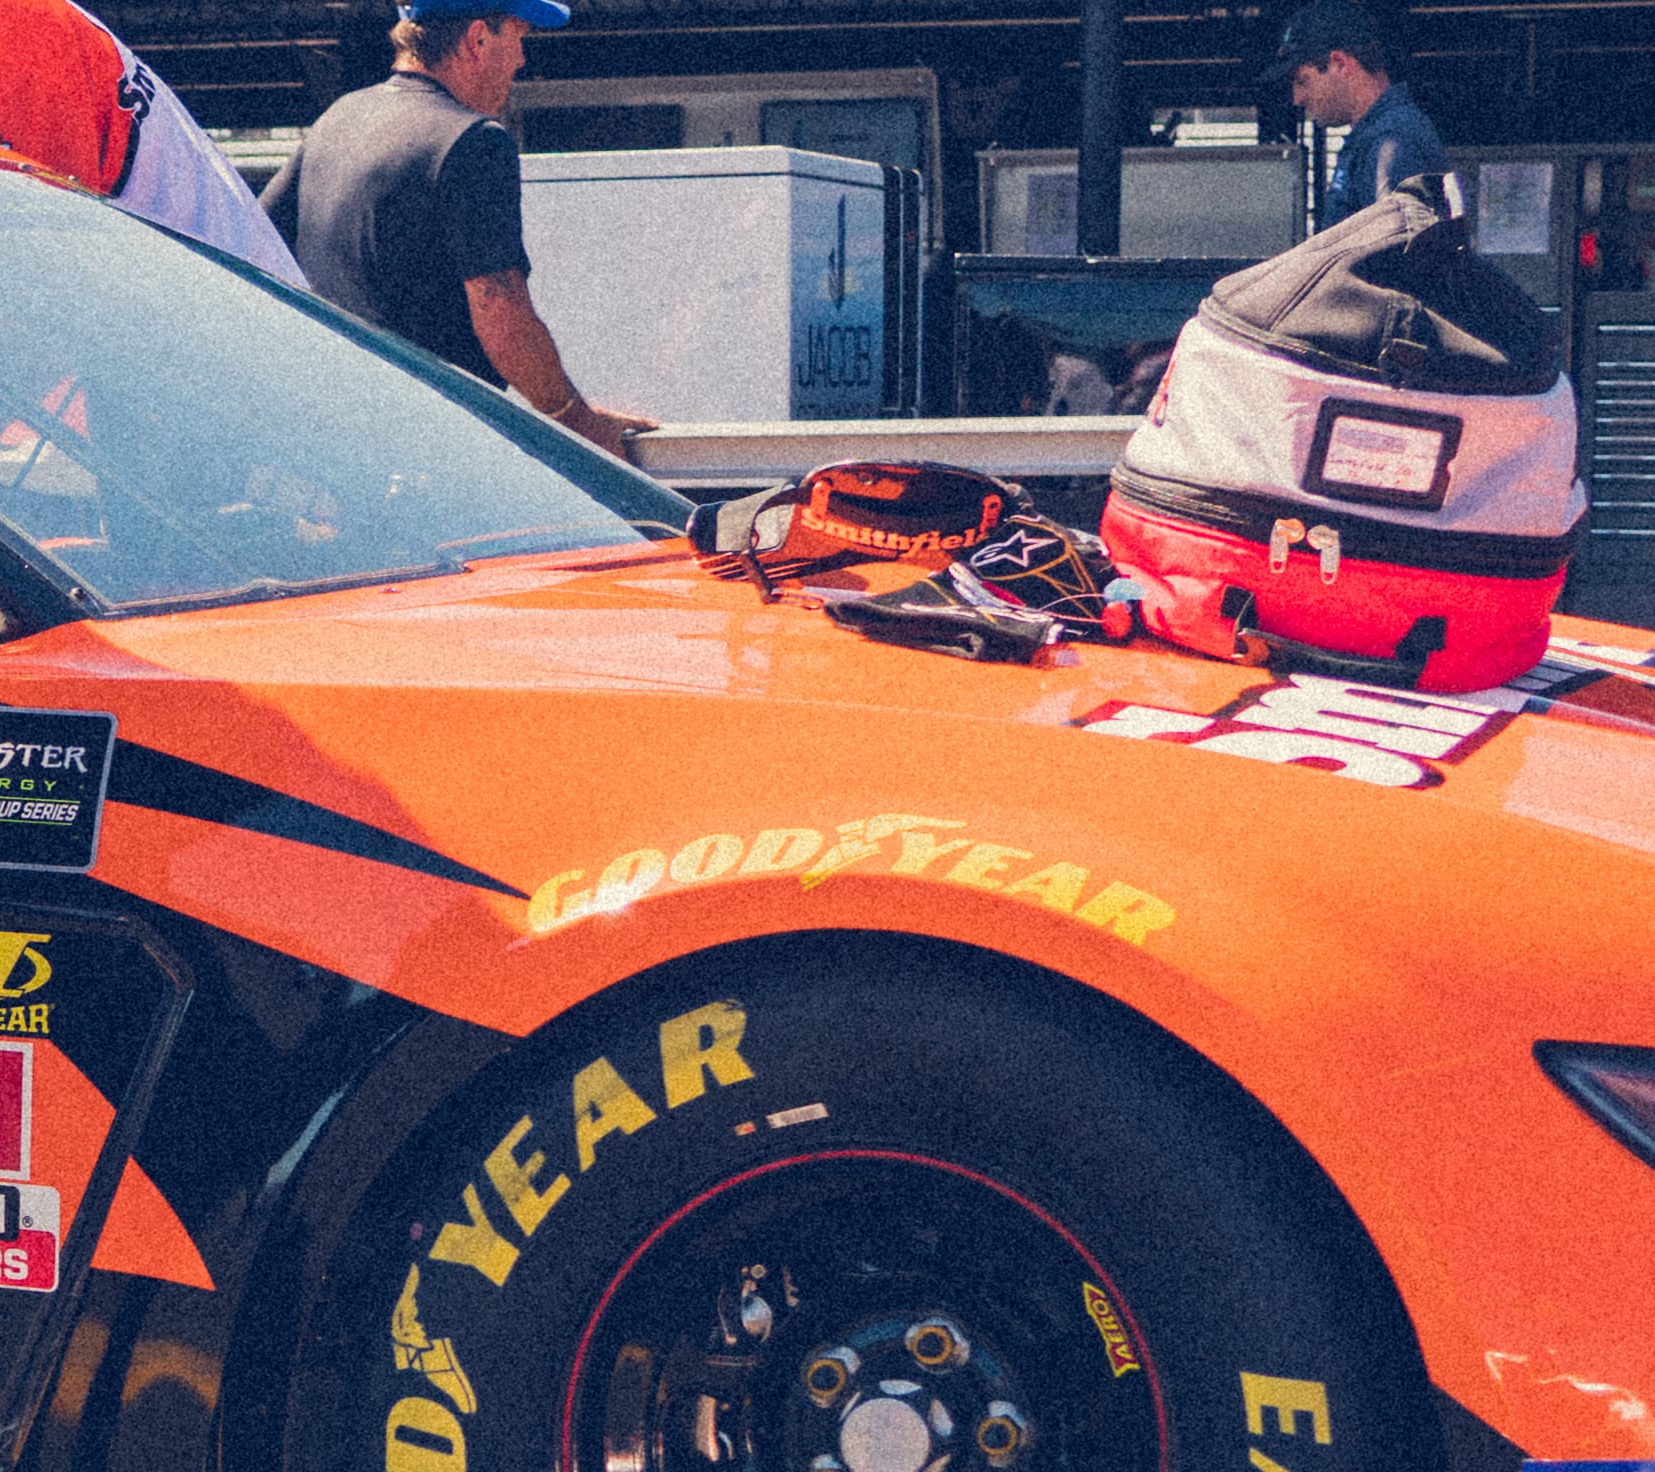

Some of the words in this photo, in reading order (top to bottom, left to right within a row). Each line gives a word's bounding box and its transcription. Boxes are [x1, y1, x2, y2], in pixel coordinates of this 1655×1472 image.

[797, 324, 872, 388] JACOB
[800, 507, 986, 559] Smithfiel
[21, 802, 80, 822] SERIES
[527, 813, 1176, 947] GOODYEAR
[1093, 1299, 1132, 1359] AERO
